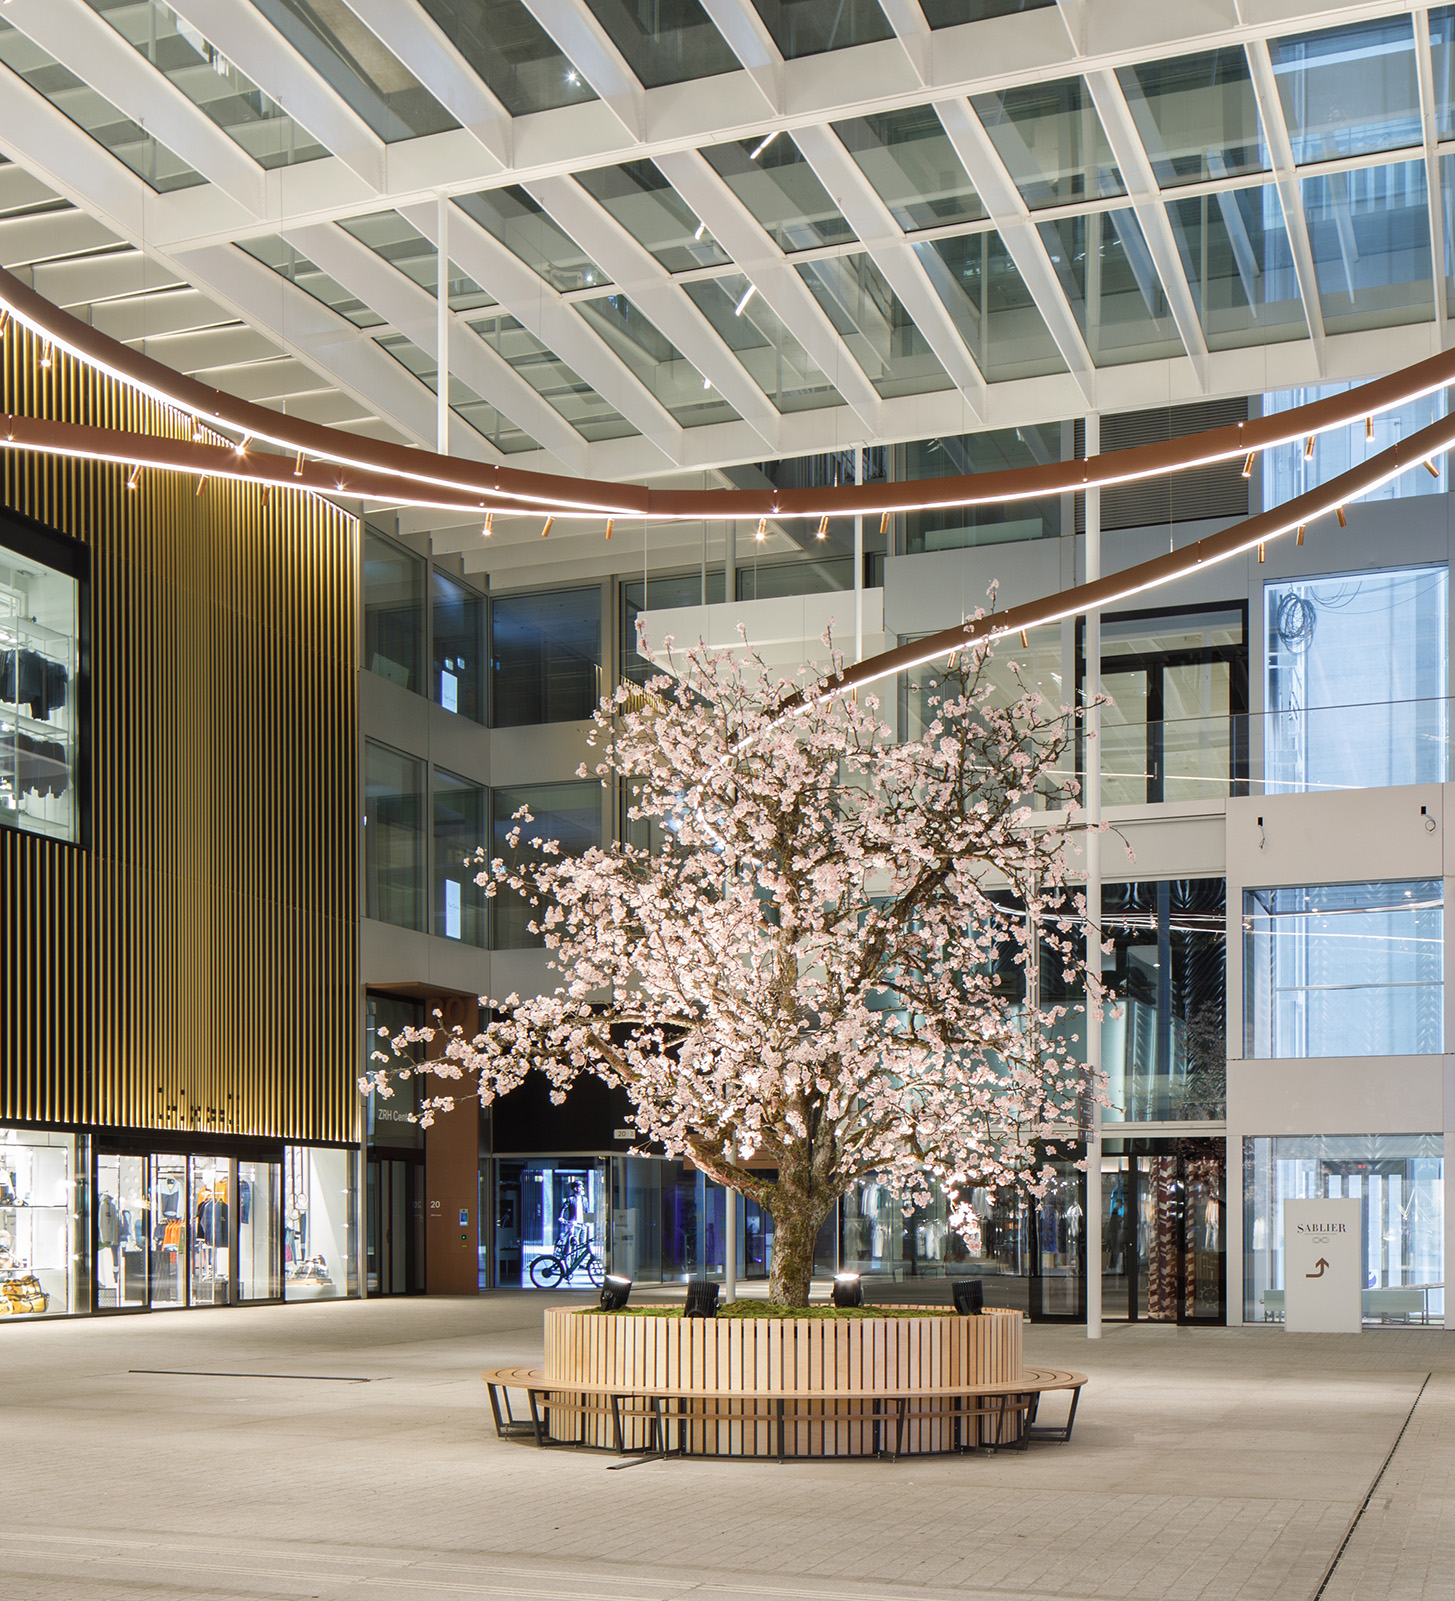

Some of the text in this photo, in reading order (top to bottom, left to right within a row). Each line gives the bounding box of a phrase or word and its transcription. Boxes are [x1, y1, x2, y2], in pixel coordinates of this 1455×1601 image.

[378, 1109, 411, 1121] ZRH Cent
[430, 1200, 441, 1209] 20
[1296, 1223, 1347, 1233] SABLIER
